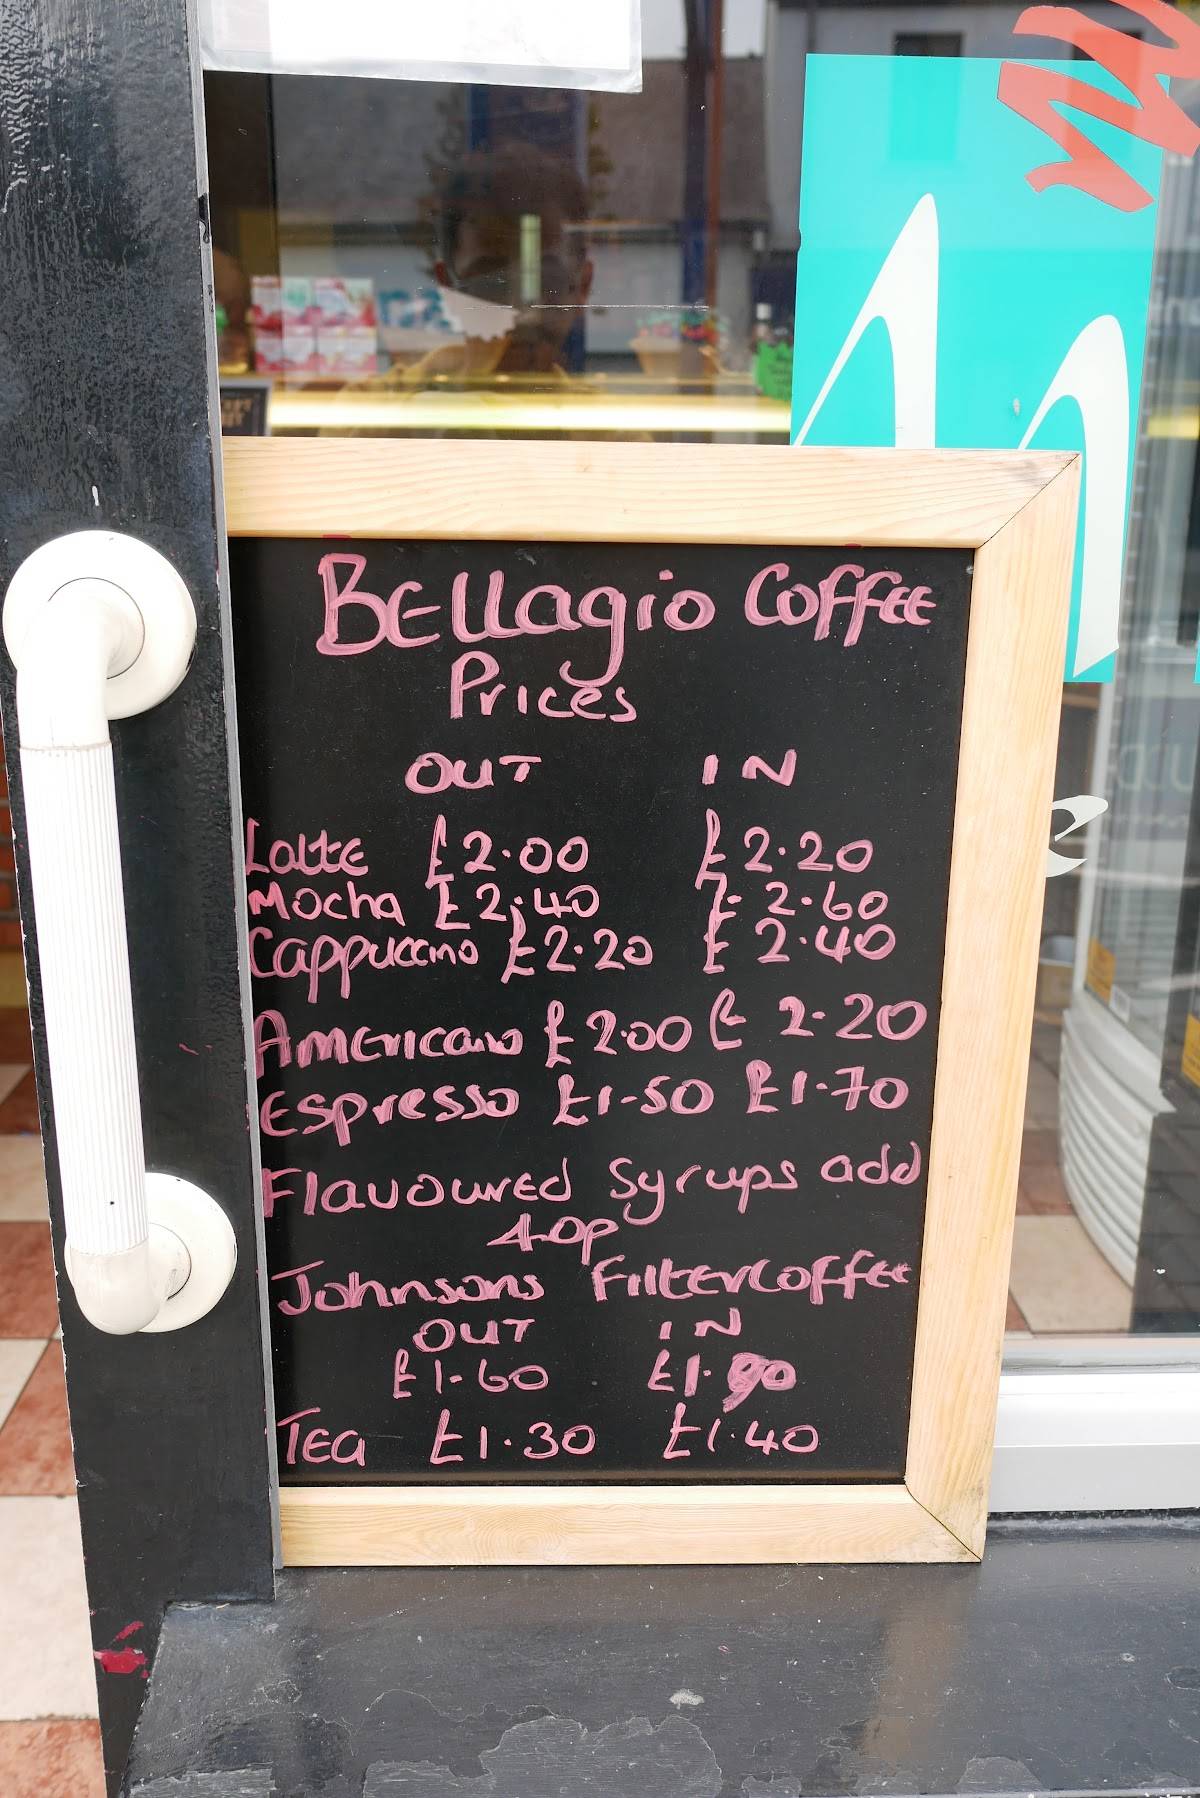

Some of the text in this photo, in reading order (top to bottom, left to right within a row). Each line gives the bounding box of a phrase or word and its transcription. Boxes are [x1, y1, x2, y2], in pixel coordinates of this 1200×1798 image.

[450, 650, 637, 723] Prices
[405, 751, 797, 795] OUT IN
[248, 881, 405, 927] Mocha
[259, 1090, 520, 1147] Espresso
[262, 1141, 922, 1227] Flavoured Syrups add
[276, 1261, 545, 1316] Johnsons
[413, 1307, 742, 1353] OUT IN
[277, 1402, 819, 1467] Tea £1.30 £1.40
